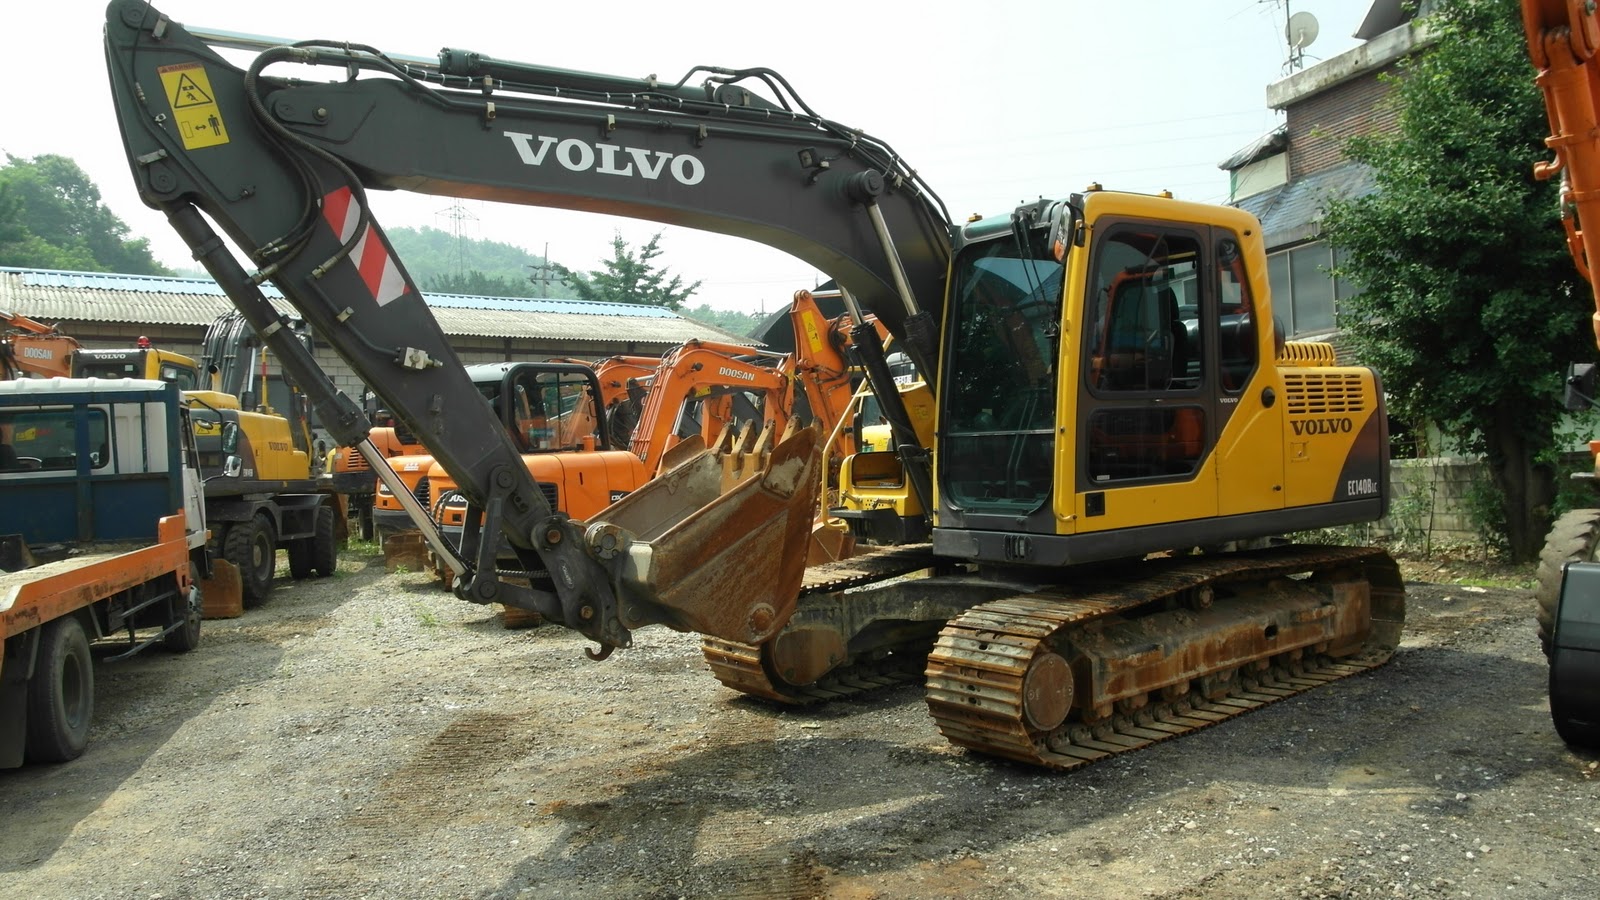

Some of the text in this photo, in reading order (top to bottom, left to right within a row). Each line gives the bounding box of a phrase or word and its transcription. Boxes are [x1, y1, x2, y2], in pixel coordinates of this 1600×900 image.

[503, 131, 706, 186] VOLVO
[24, 347, 52, 360] DOOSAN
[719, 366, 756, 381] DOOSAN
[1290, 417, 1353, 436] VOLVO
